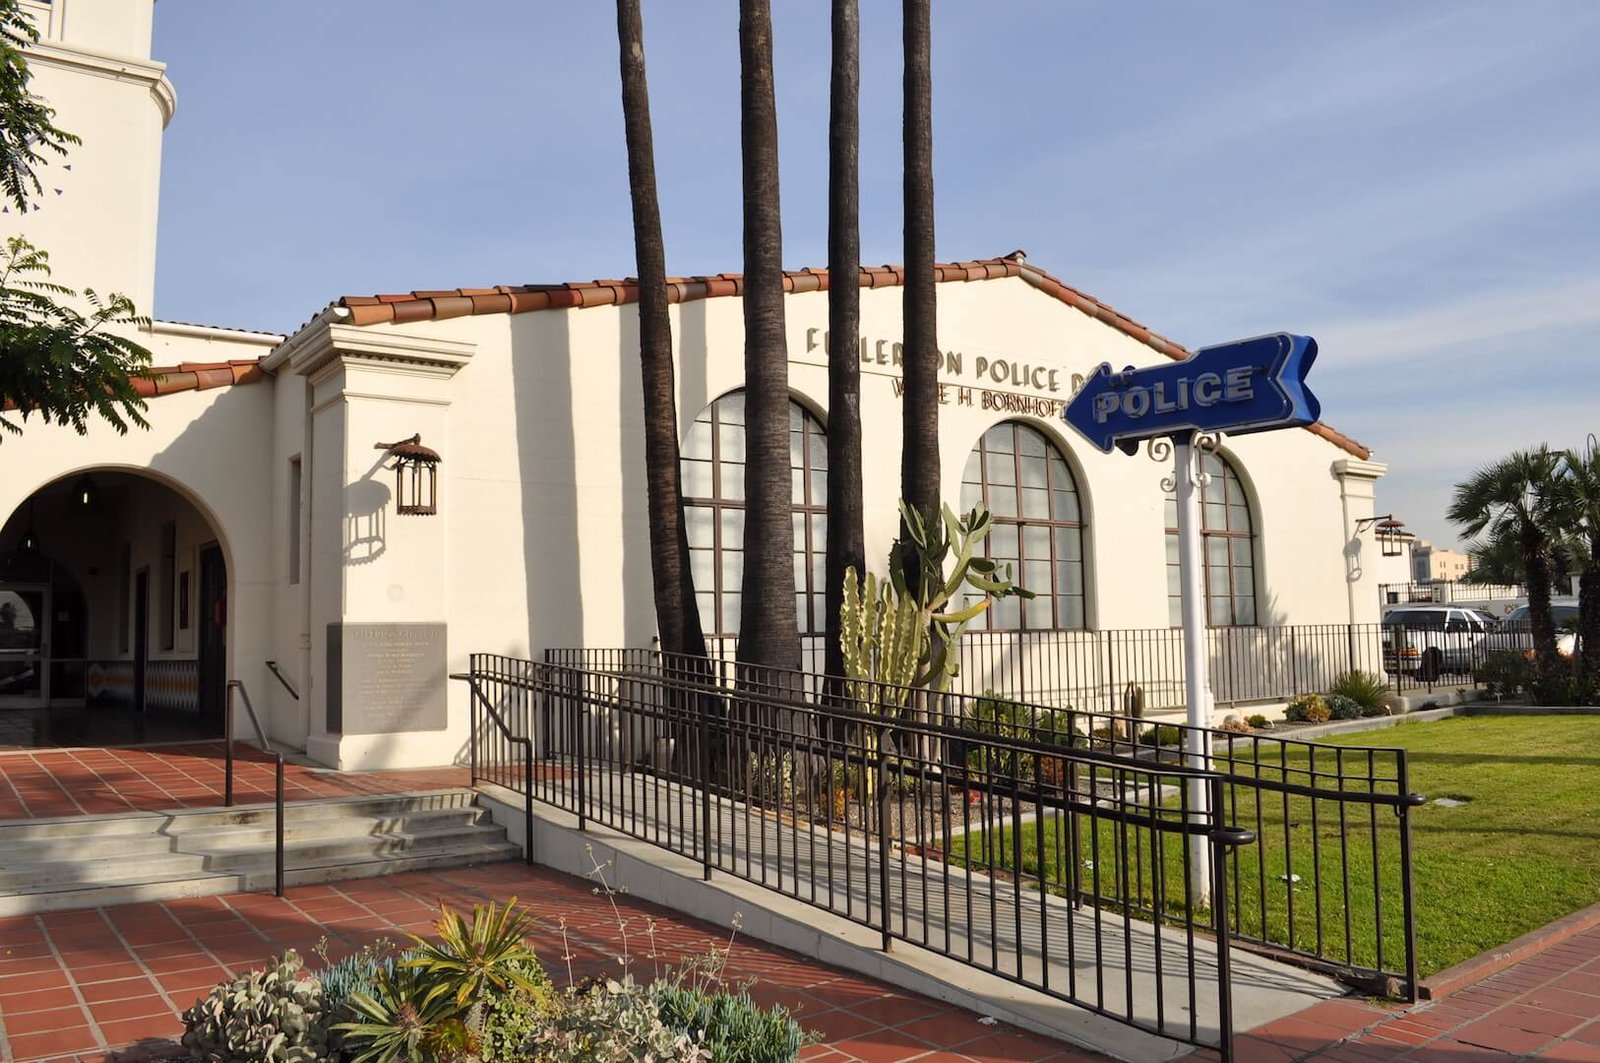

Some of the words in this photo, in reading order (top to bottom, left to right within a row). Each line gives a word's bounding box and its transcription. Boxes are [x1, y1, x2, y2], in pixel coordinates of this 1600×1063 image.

[806, 327, 963, 376] FLERN
[975, 356, 1061, 392] POLICE
[1093, 366, 1254, 424] POLICE
